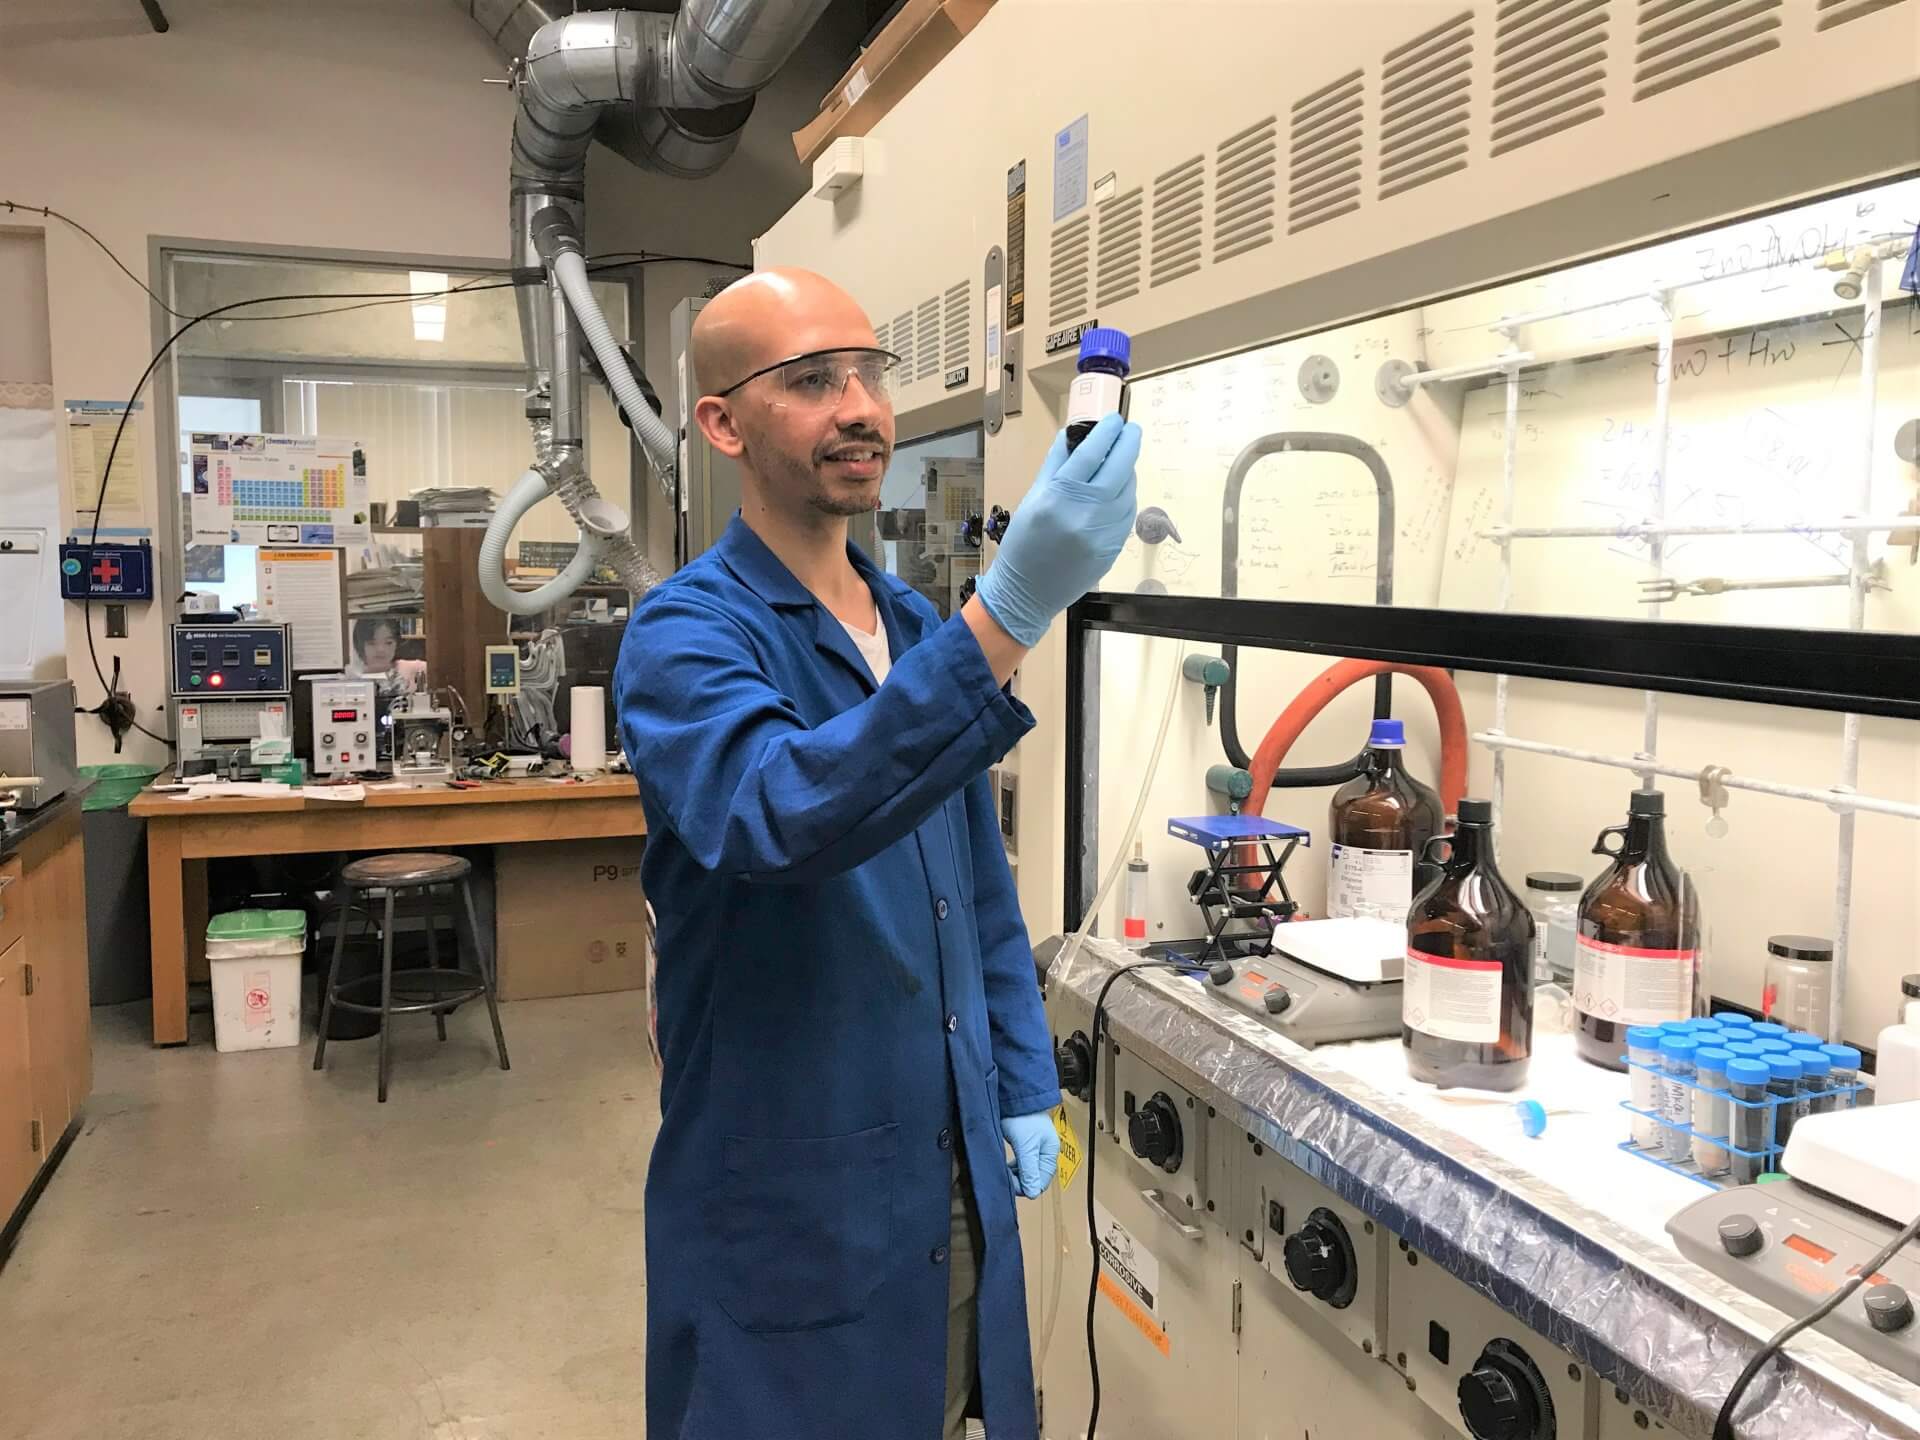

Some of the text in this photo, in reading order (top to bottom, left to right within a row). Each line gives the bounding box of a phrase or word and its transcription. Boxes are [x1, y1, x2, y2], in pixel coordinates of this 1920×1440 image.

[1046, 328, 1077, 351] SAFEAIRE
[90, 584, 123, 593] FIRST AID
[593, 864, 618, 882] P9
[1099, 1243, 1145, 1298] CORROSIVE
